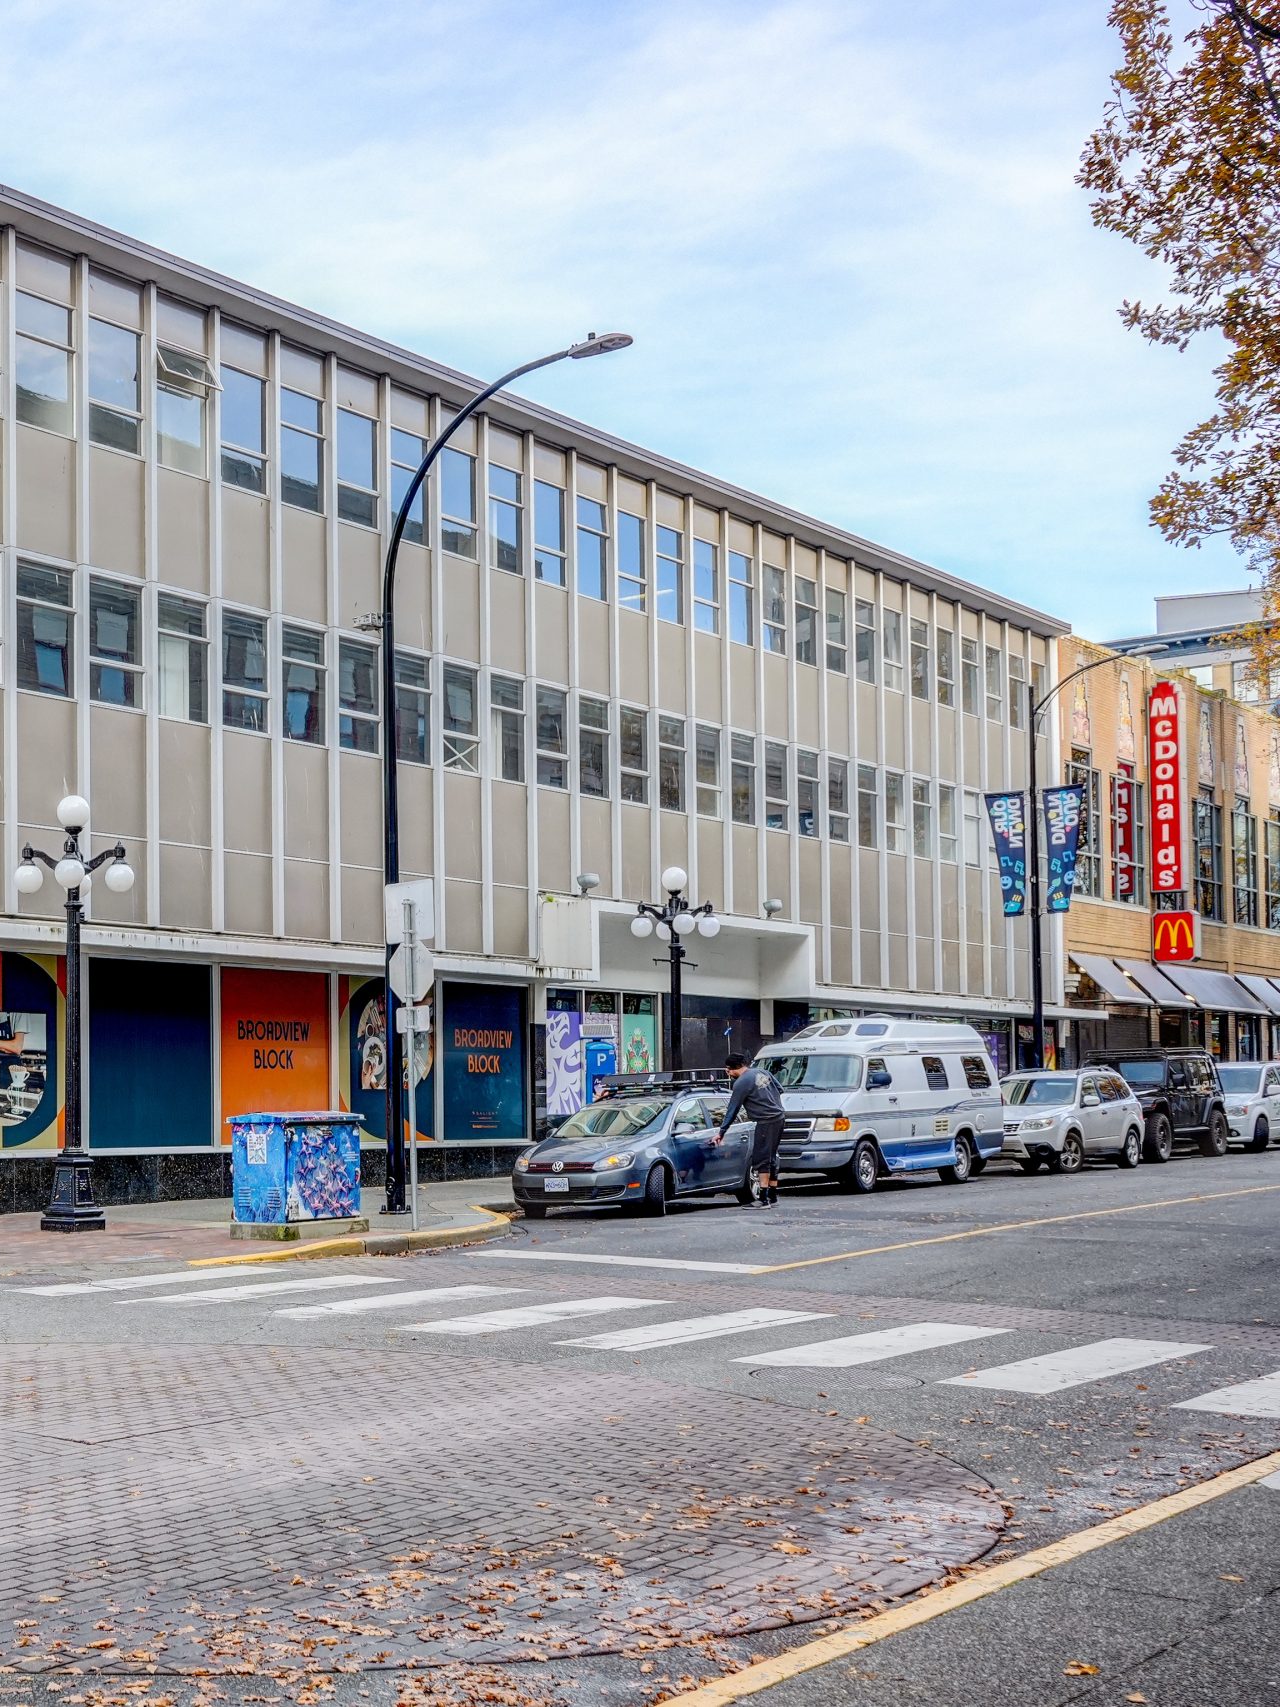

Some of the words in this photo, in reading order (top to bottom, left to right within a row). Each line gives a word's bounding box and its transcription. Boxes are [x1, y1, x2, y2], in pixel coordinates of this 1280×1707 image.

[1150, 696, 1178, 888] McDonald's
[238, 1020, 310, 1042] BROADVIEW
[454, 1028, 512, 1048] BROADVIEW
[254, 1049, 294, 1070] BLOCK
[468, 1054, 500, 1074] BLOCK
[597, 1053, 606, 1066] P
